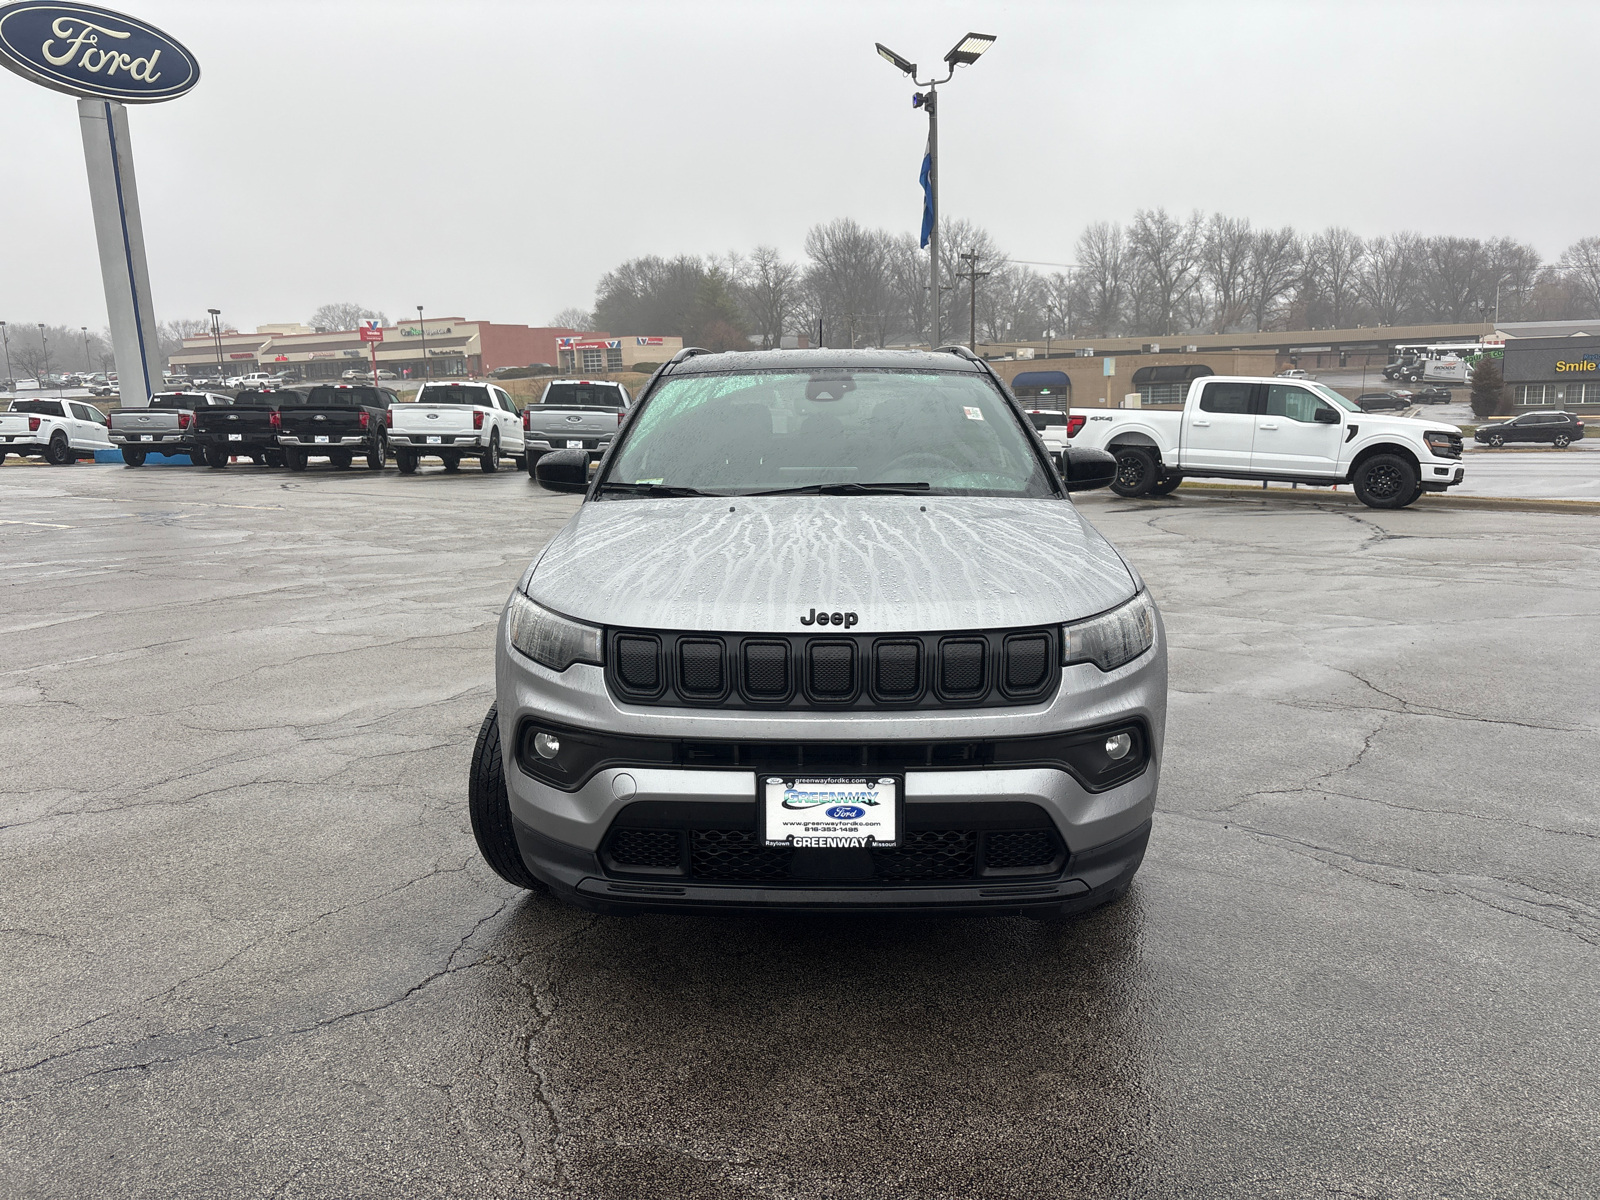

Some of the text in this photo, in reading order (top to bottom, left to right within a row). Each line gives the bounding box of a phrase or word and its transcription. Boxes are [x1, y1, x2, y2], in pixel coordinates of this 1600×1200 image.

[42, 16, 162, 84] Ford
[1555, 360, 1597, 372] Smile
[800, 608, 859, 629] Jeep
[794, 777, 867, 785] greenwayfordkc.com
[784, 789, 879, 804] GREENWAY
[833, 807, 858, 818] Ford
[793, 836, 868, 848] GREENWAY
